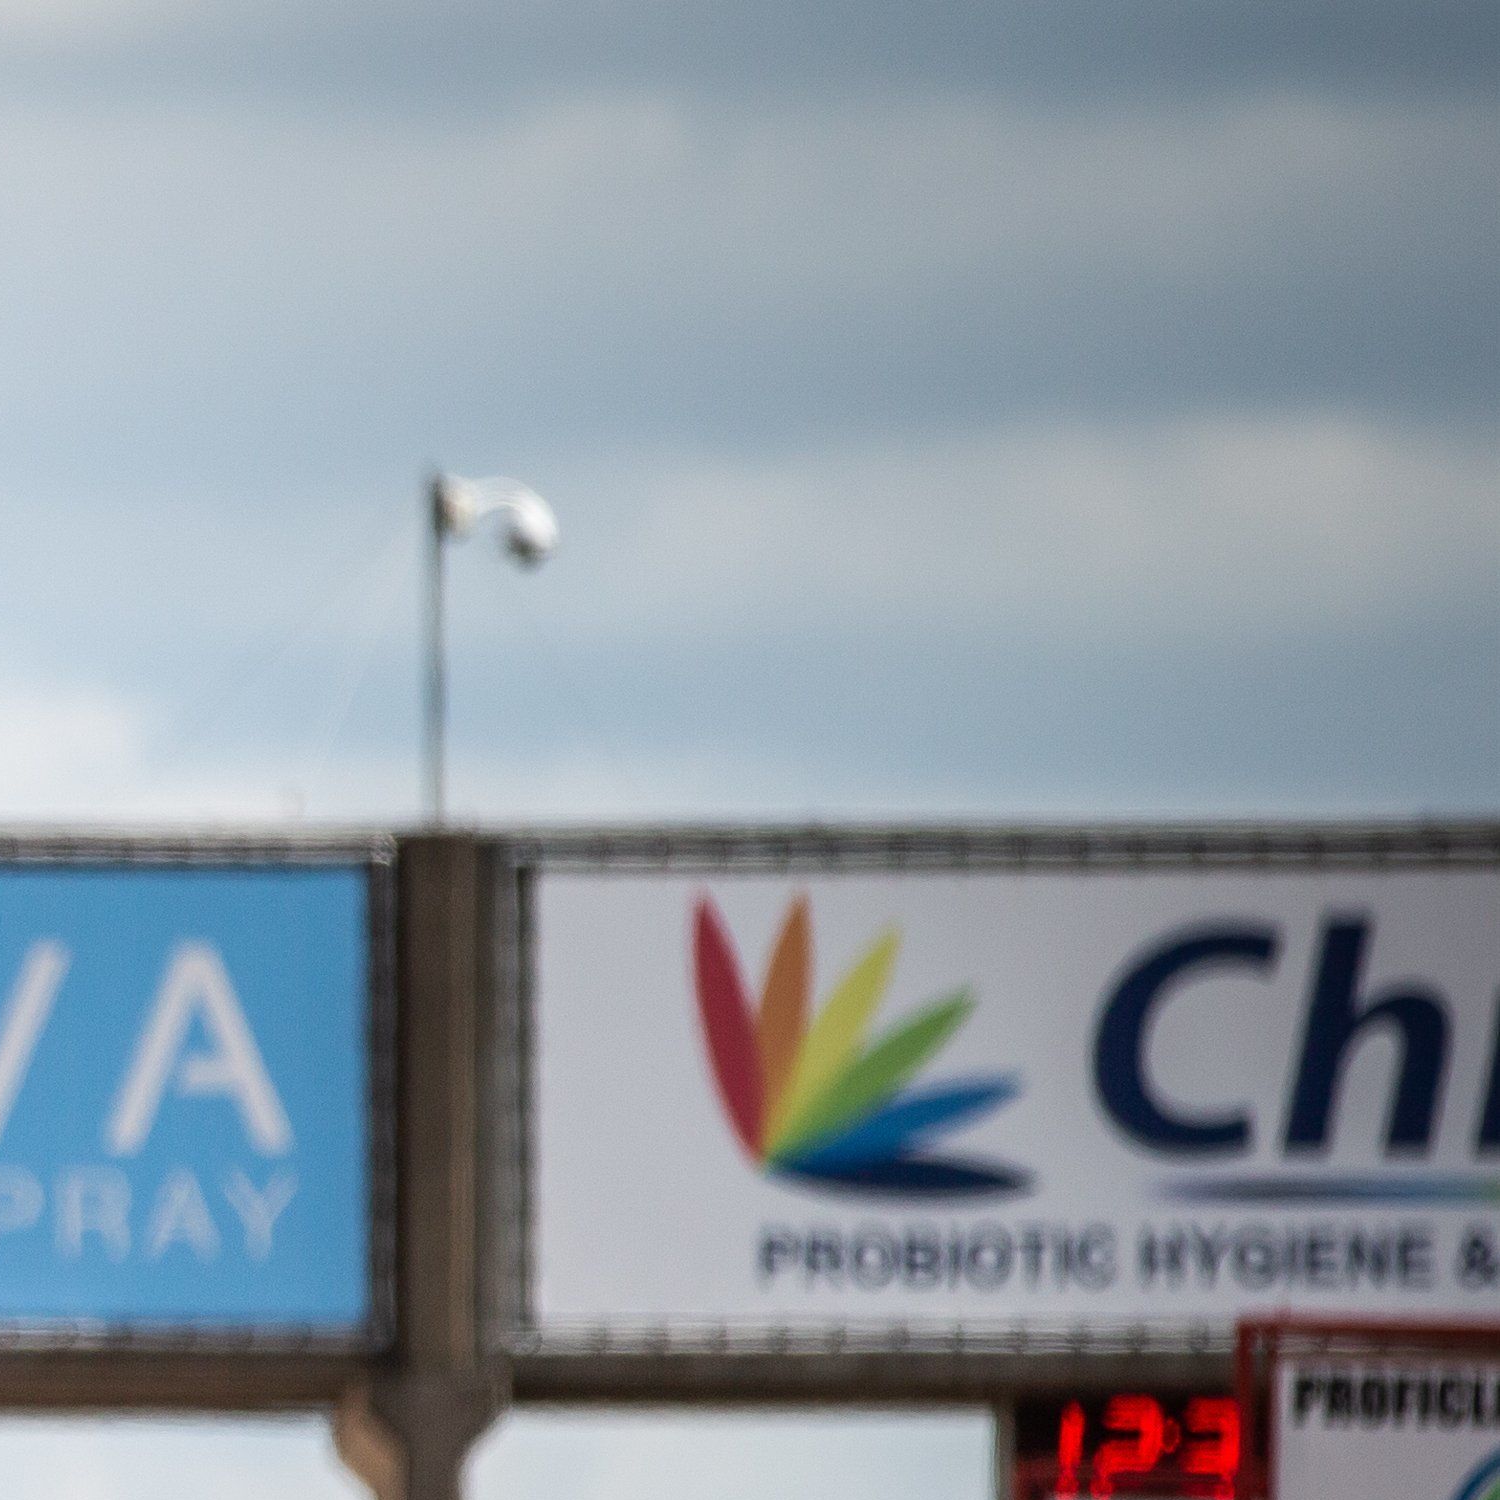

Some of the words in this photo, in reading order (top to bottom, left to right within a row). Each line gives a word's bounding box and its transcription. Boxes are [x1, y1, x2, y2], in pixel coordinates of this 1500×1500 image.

[757, 1222, 1115, 1292] PROBIOTIC
[1138, 1222, 1436, 1293] HYGIENE
[1293, 1374, 1500, 1430] PROFICL
